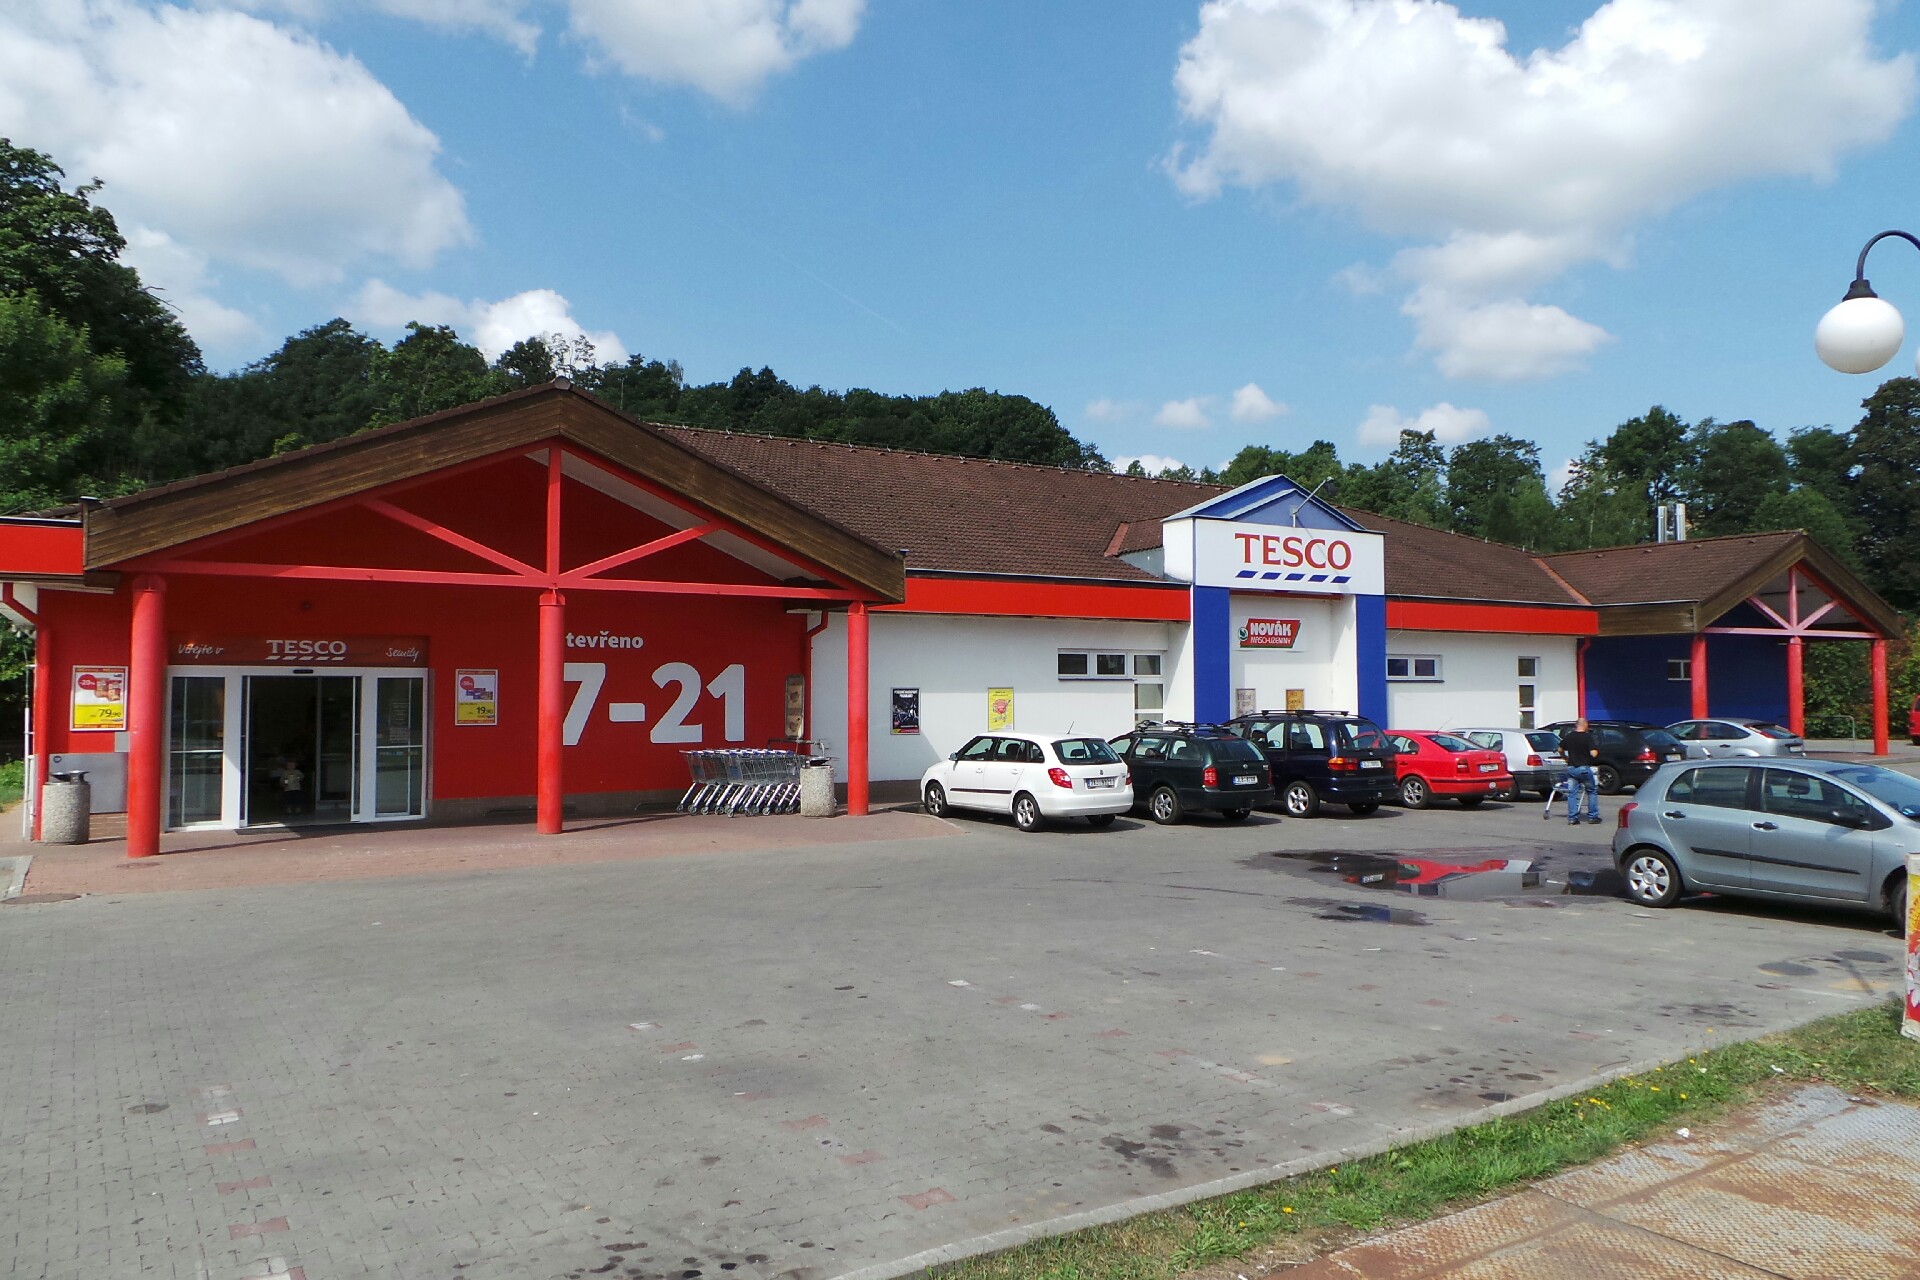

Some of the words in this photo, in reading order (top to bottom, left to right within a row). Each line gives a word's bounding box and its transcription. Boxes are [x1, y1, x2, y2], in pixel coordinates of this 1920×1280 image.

[1235, 533, 1352, 570] TESCO
[1250, 621, 1292, 637] NOVÁK
[266, 639, 347, 655] TESCO
[565, 631, 644, 649] tevřeno
